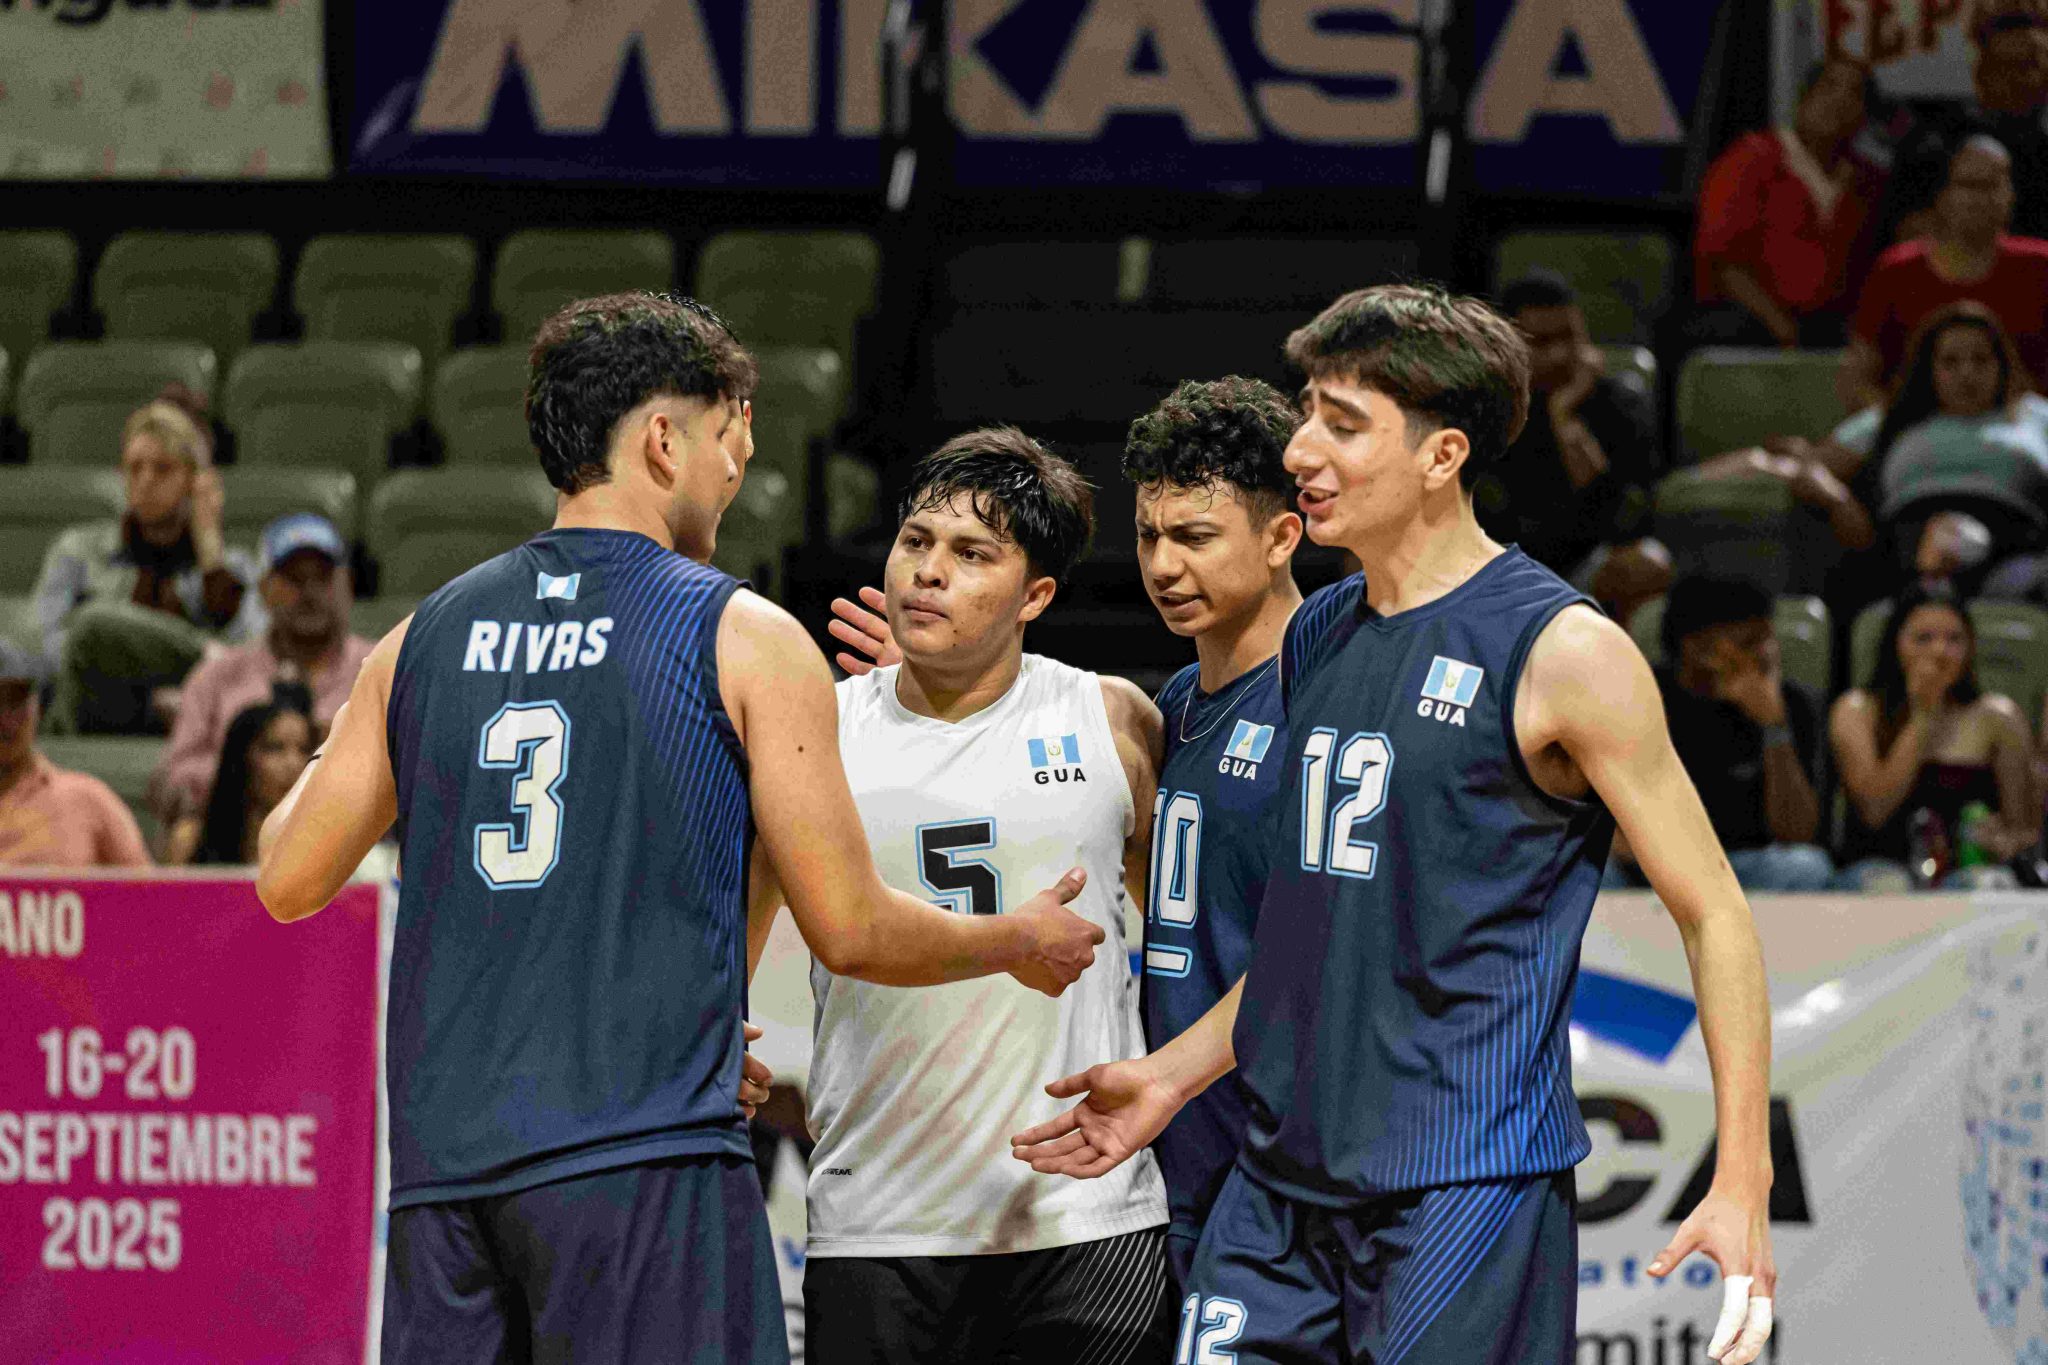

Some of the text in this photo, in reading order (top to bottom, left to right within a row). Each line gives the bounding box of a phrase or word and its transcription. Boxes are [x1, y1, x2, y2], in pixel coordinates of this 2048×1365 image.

[410, 0, 1686, 142] MIKASA
[462, 616, 615, 674] RIVAS
[1417, 698, 1467, 728] GUA
[473, 699, 572, 892] 3
[1033, 767, 1087, 785] GUA
[1218, 756, 1258, 781] GUA
[1301, 725, 1396, 880] 12
[915, 816, 1003, 914] 5
[37, 1026, 197, 1101] 16-20
[0, 1111, 318, 1187] SEPTIEMBRE
[41, 1197, 182, 1271] 2025
[1175, 1292, 1249, 1365] 12
